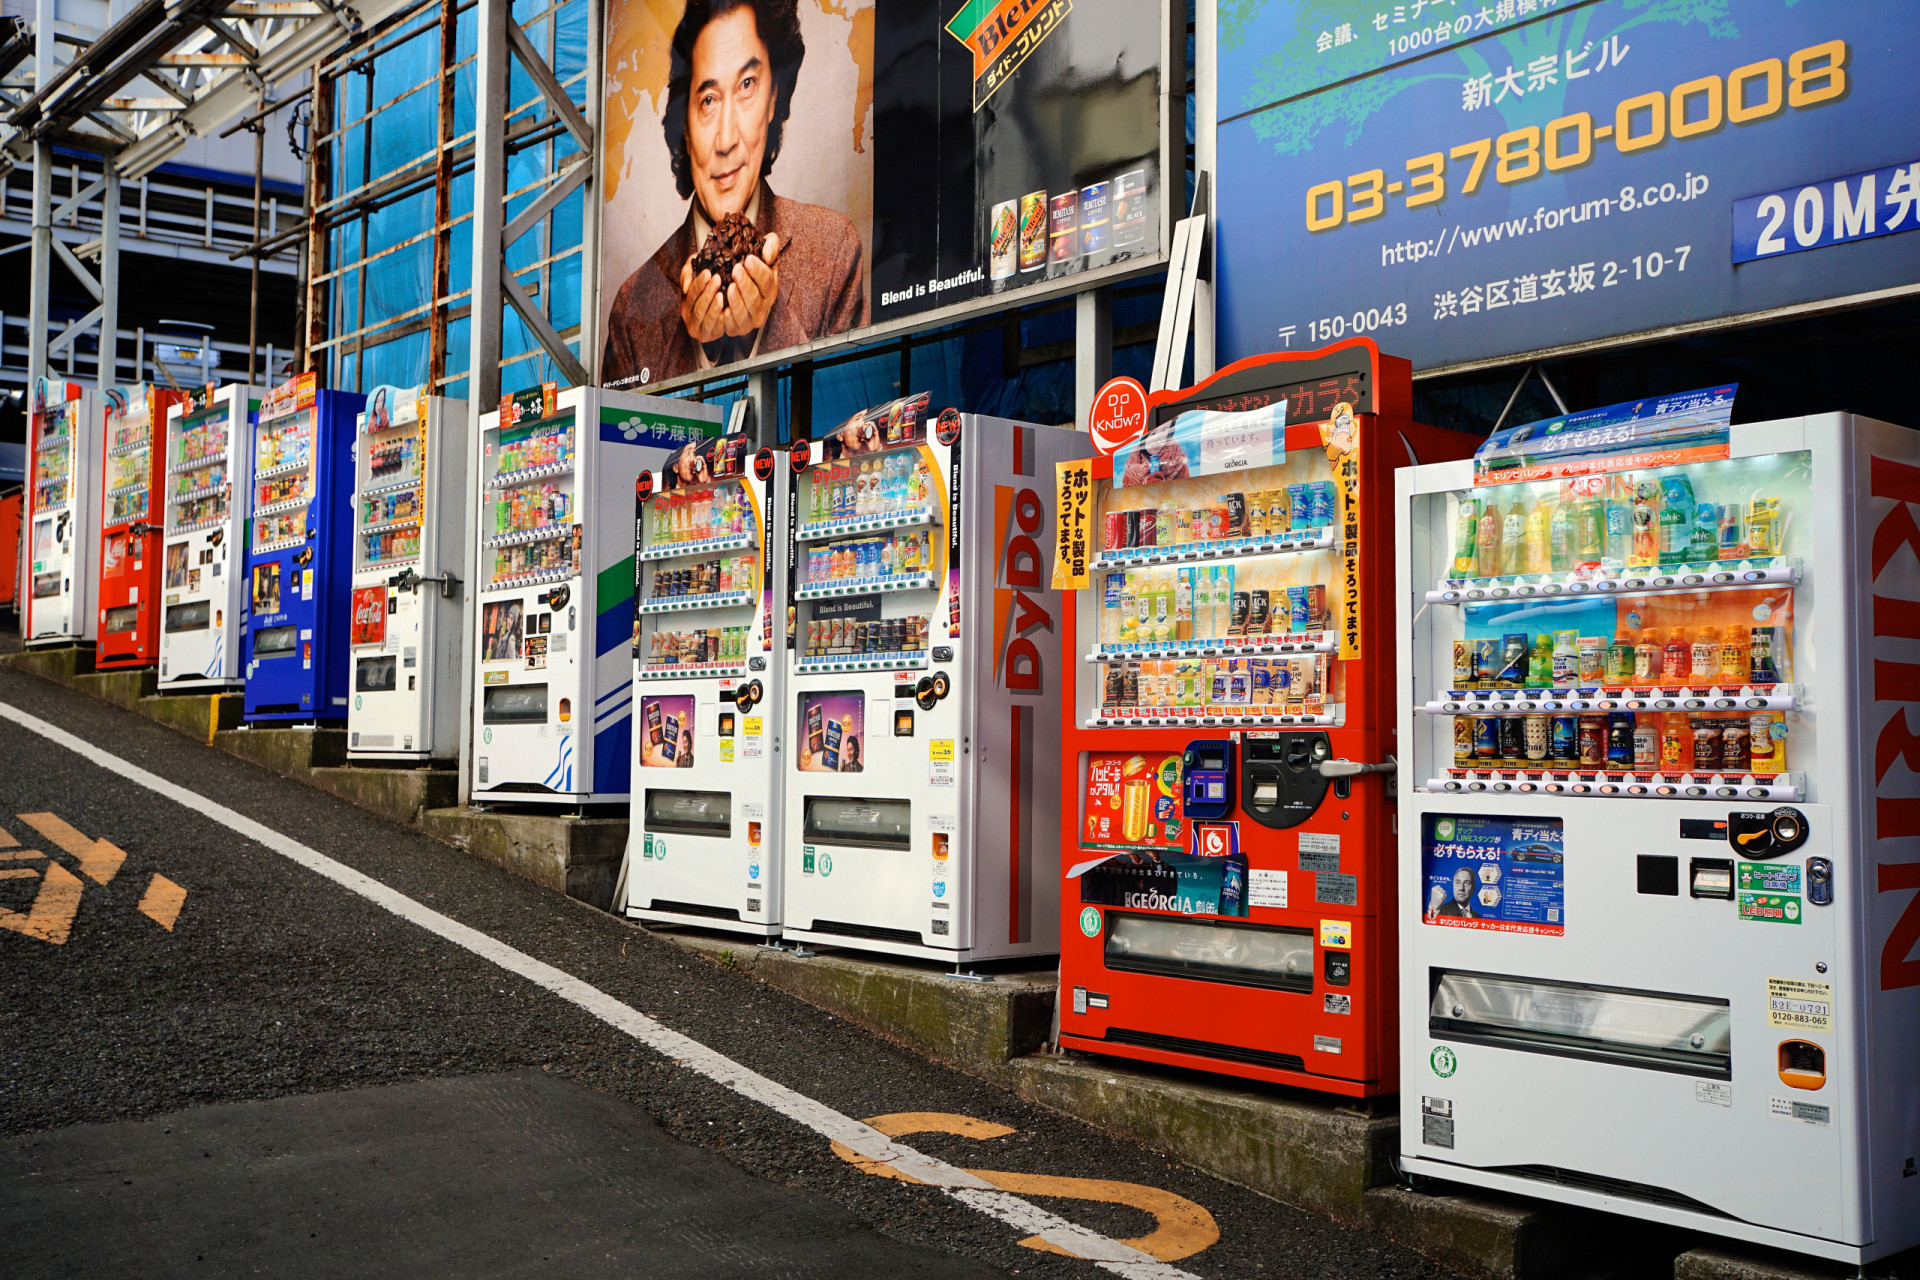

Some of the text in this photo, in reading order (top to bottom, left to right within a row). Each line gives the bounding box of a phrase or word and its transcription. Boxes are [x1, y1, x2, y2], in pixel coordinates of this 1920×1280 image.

[986, 0, 1066, 89] ダイドーブレンド
[1462, 35, 1630, 111] 新大宗ビル
[1306, 39, 1846, 232] 03-3780-0008
[1126, 211, 1143, 221] BLACK
[1382, 171, 1709, 267] http://www.forum-8.co.jp
[881, 267, 985, 306] Blend is Beautiful.
[1433, 245, 1692, 321] 渋谷区道玄坂 2-10-7
[1307, 302, 1409, 343] 150-0043
[1096, 412, 1141, 433] KNOW?
[1113, 406, 1124, 420] U
[650, 421, 704, 443] 伊藤園
[937, 420, 960, 433] NEW!
[755, 459, 774, 471] NEW!
[791, 450, 810, 462] NEW!
[1224, 459, 1248, 469] GEORGIA
[813, 466, 850, 485] DyDo
[637, 480, 654, 492] NEW!
[655, 494, 686, 513] DyDo
[1060, 470, 1072, 565] そろってます。
[1072, 468, 1089, 577] ホットな製品
[1006, 488, 1050, 689] DyDo
[356, 602, 382, 625] Coca-Cola
[819, 600, 874, 614] Blend is Beautiful.
[1091, 766, 1121, 782] ハッピー缶
[1434, 843, 1501, 861] 必ずもらえる!
[1132, 887, 1192, 913] GEORGIA
[1742, 906, 1783, 918] LED照明
[1772, 1000, 1827, 1015] B2E-0721
[1772, 1012, 1827, 1025] 0120-883-065
